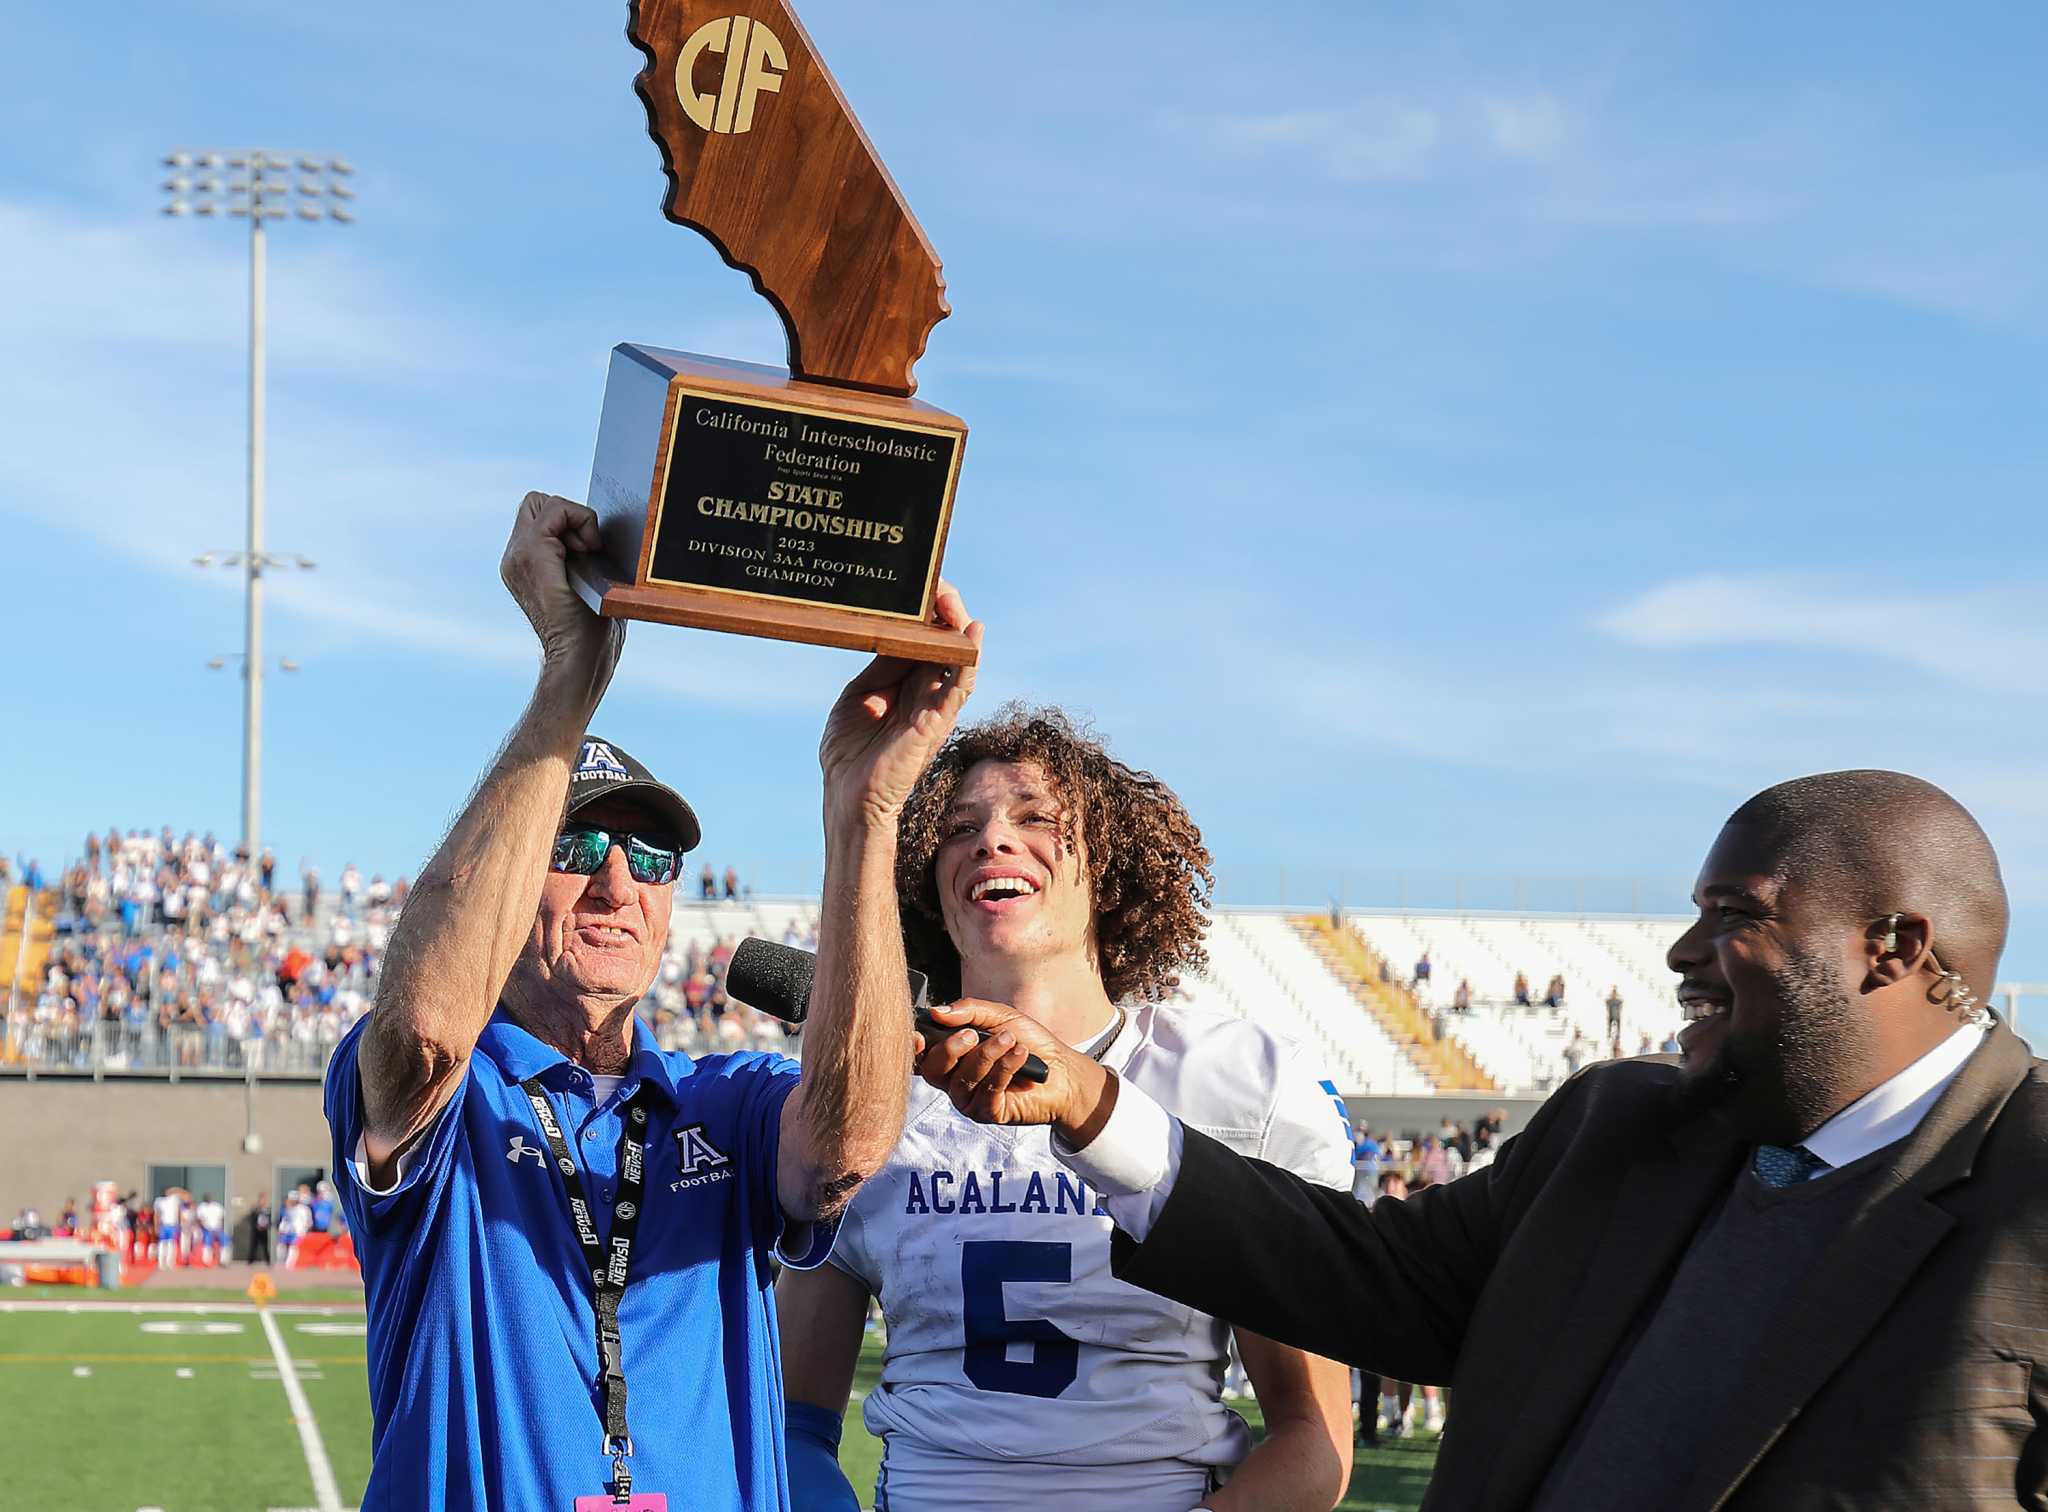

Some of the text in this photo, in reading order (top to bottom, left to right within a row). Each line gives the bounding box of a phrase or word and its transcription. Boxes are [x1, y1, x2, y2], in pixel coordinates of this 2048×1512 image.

[675, 15, 789, 134] CIF
[696, 408, 937, 462] California Interscholastic
[764, 443, 860, 474] Federation
[768, 481, 843, 509] STATE
[697, 496, 904, 544] CHAMPIONSHIPS
[688, 540, 898, 581] DIVISION 3AA FOOTBALL
[778, 537, 815, 552] 2023
[745, 565, 835, 587] CHAMPION
[580, 741, 627, 771] A
[677, 1127, 728, 1173] A
[670, 1169, 735, 1192] FOOTBA
[962, 1240, 1079, 1399] 6
